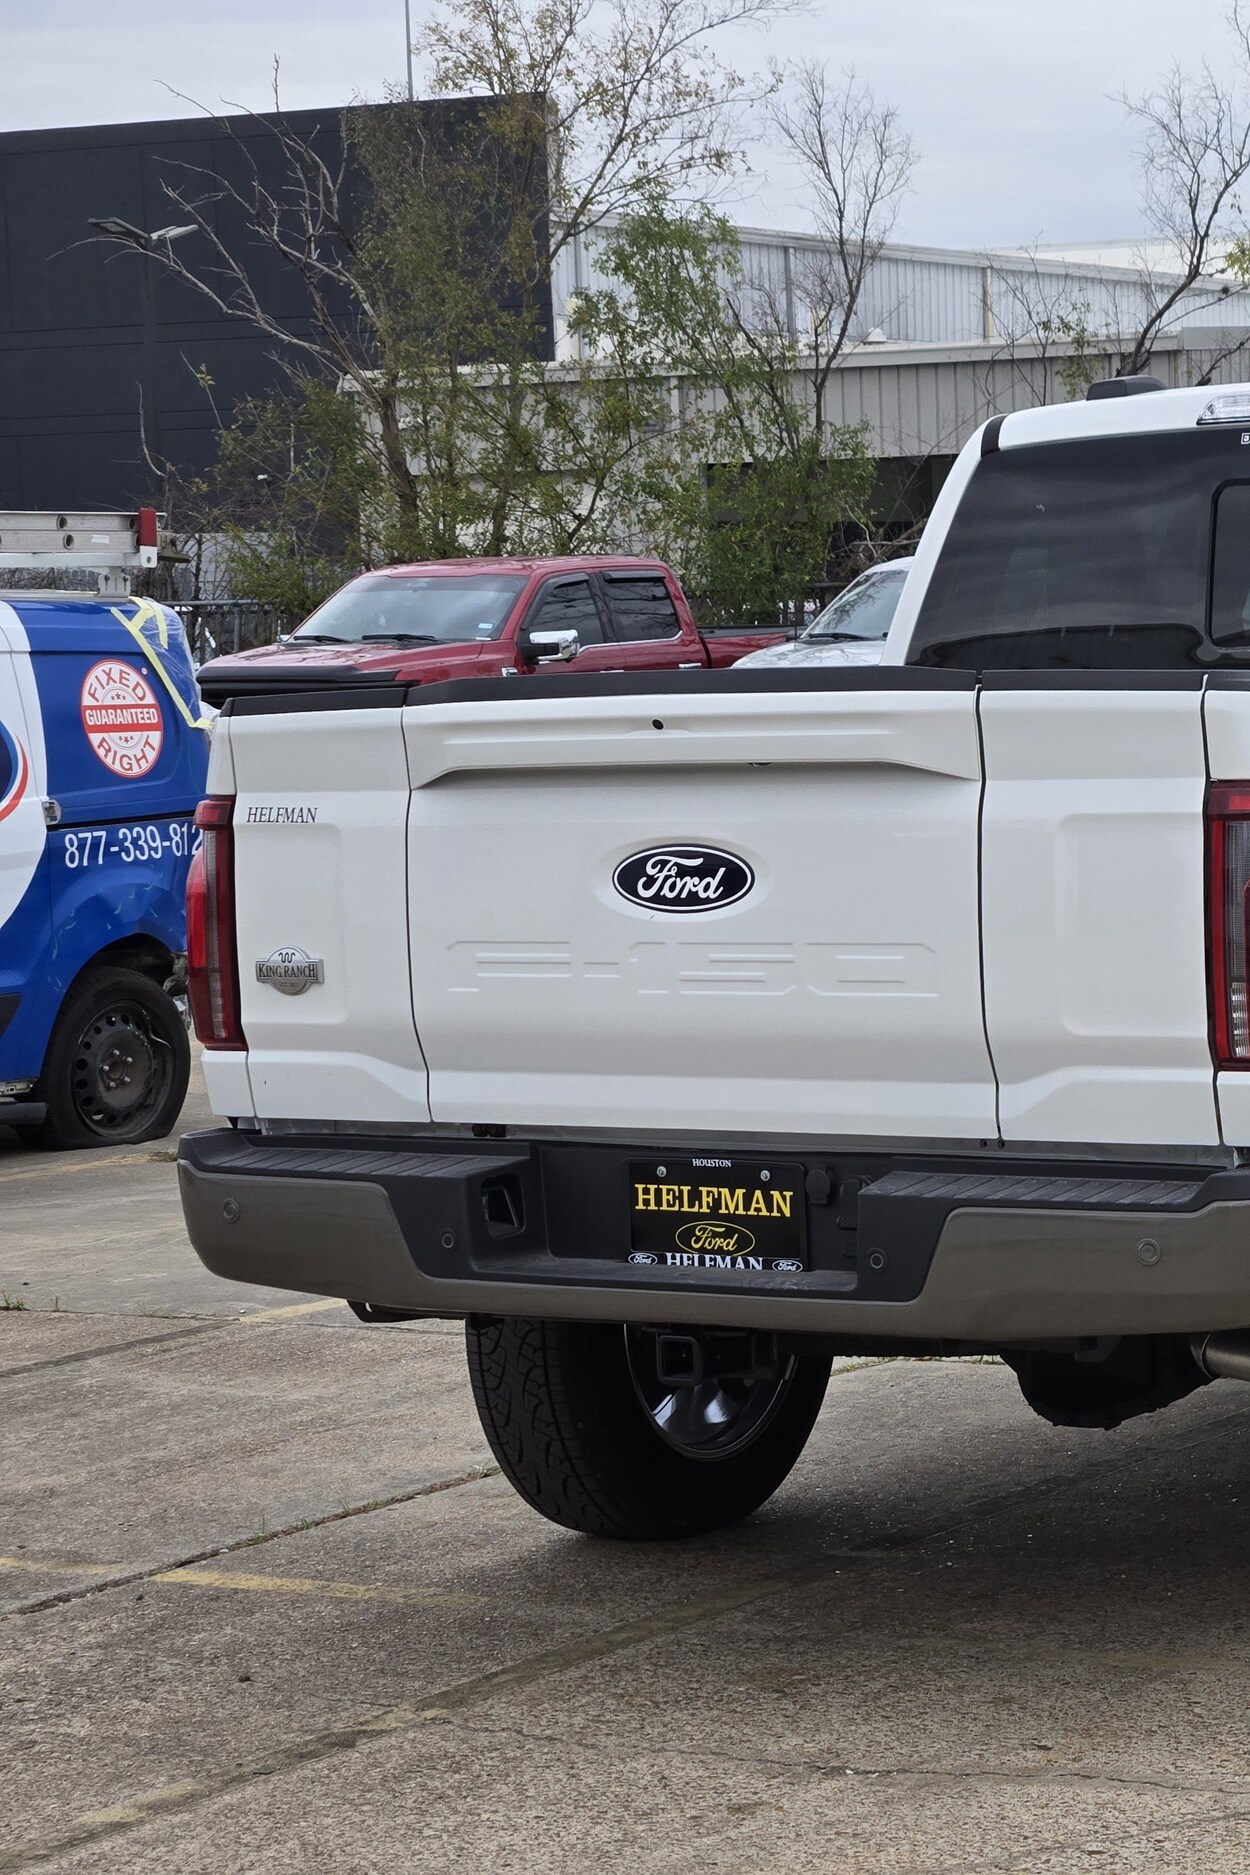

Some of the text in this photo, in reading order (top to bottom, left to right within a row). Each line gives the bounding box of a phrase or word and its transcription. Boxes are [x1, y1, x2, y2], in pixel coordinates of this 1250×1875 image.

[87, 667, 147, 703] FIXED
[85, 708, 158, 726] GUARANTEED
[97, 735, 156, 772] RIGHT
[247, 806, 318, 824] HELFMAN
[64, 822, 203, 869] 877-339-812
[637, 855, 726, 899] Ford
[258, 963, 316, 978] KING RANCH
[692, 1158, 732, 1168] HOUSTON
[634, 1183, 793, 1218] HELFMAN
[690, 1224, 738, 1251] Ford
[632, 1254, 652, 1264] Ford
[778, 1260, 798, 1271] Ford
